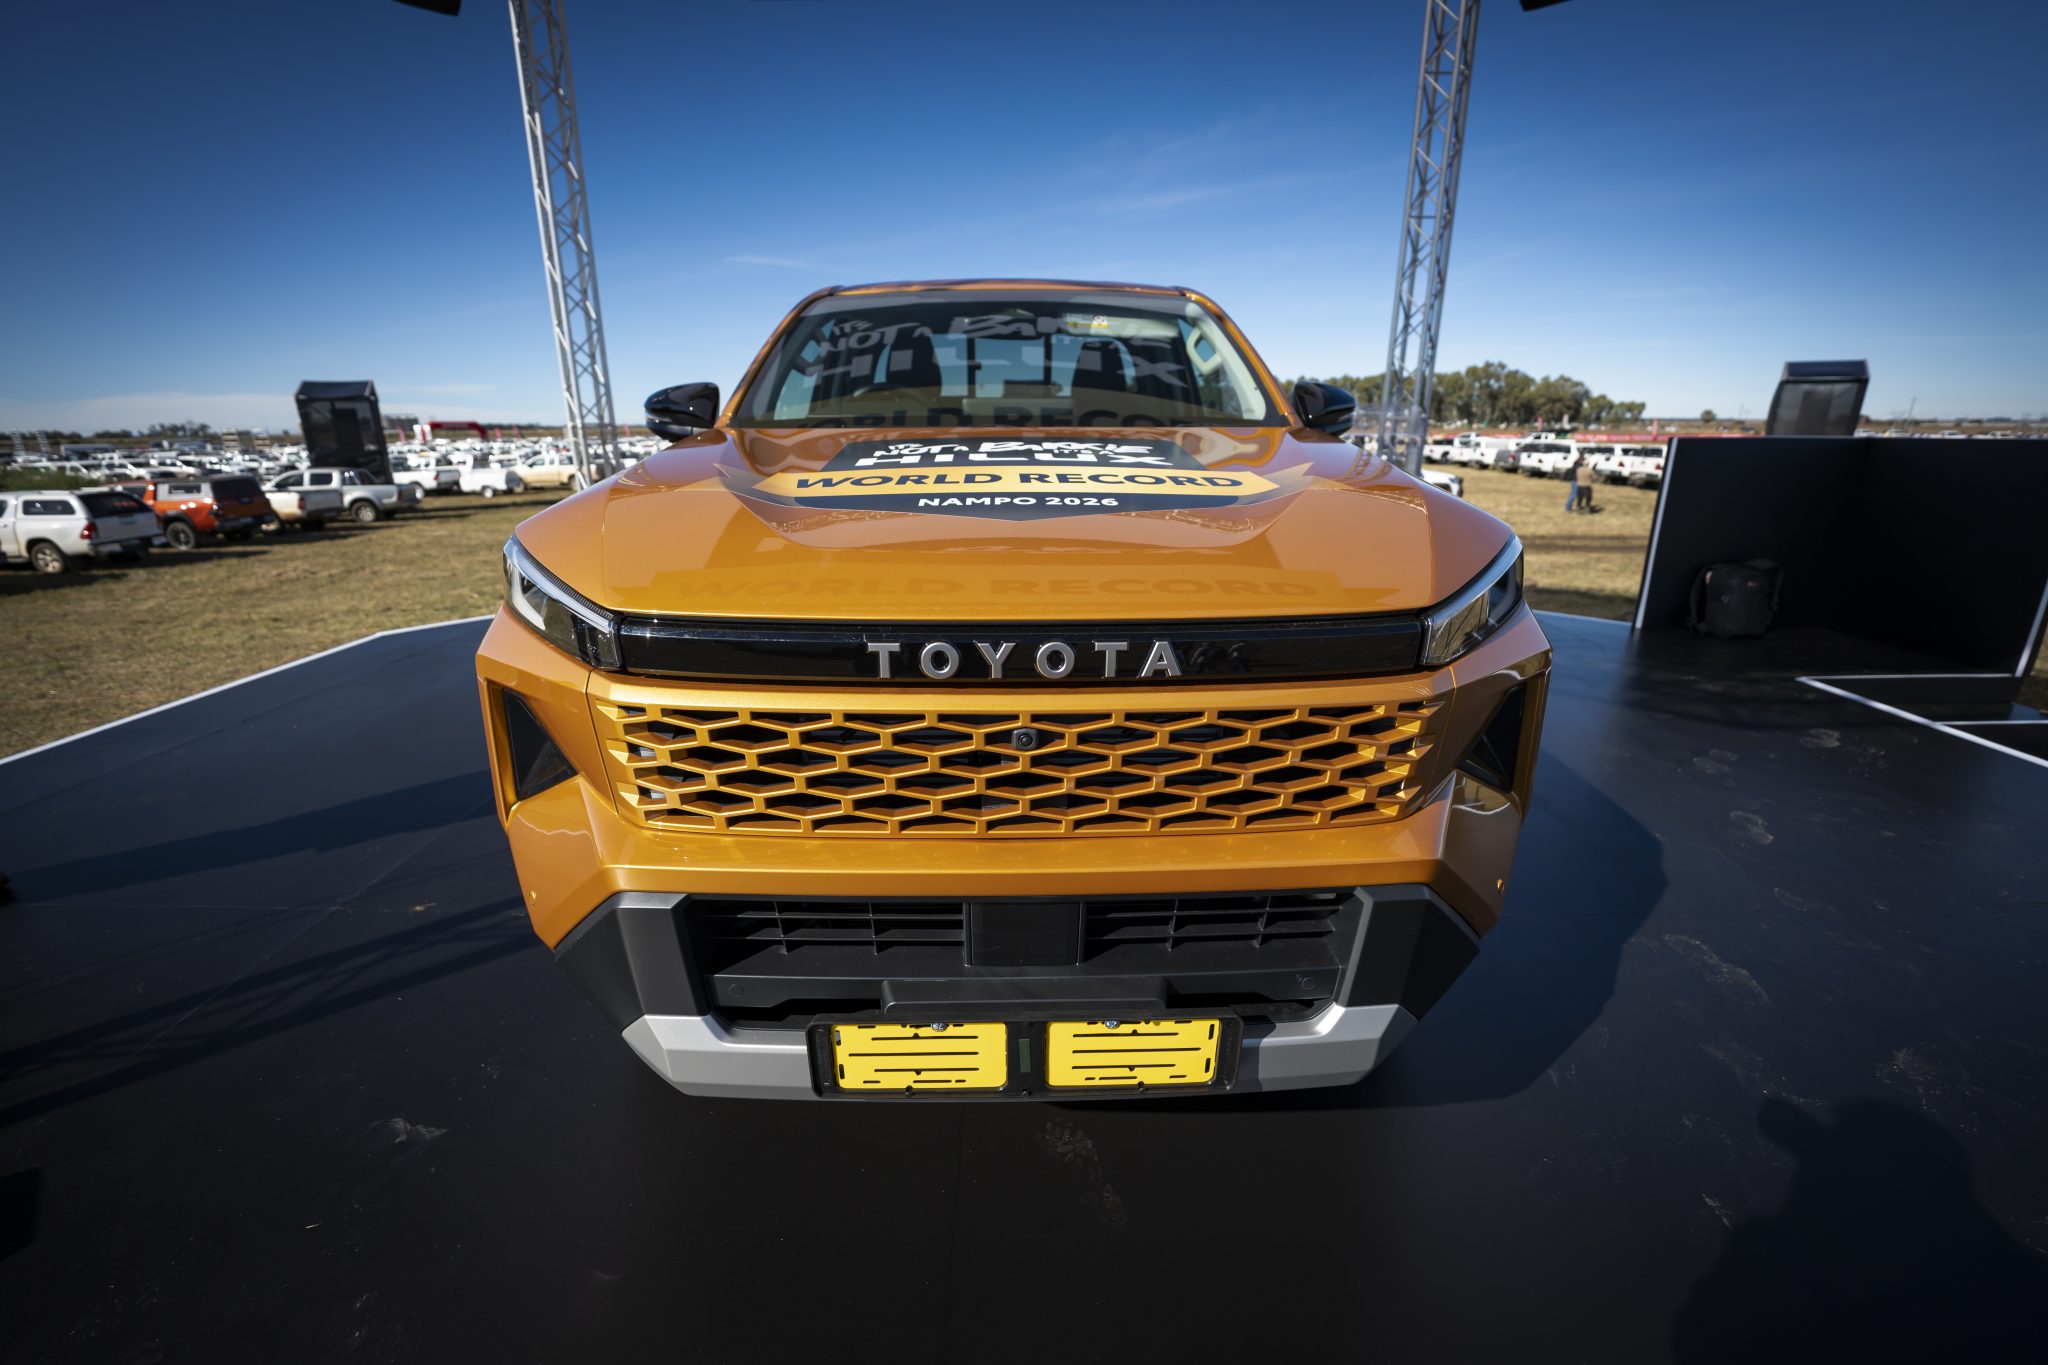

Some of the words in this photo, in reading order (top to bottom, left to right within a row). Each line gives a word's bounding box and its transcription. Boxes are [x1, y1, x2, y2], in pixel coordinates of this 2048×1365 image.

[873, 444, 960, 457] NOT
[855, 453, 1174, 466] HILUX
[796, 473, 1003, 489] WORLD
[1019, 473, 1244, 488] RECORD
[918, 496, 1037, 507] NAMPO
[1044, 496, 1119, 507] 2026
[866, 640, 1183, 680] TOYOTA
